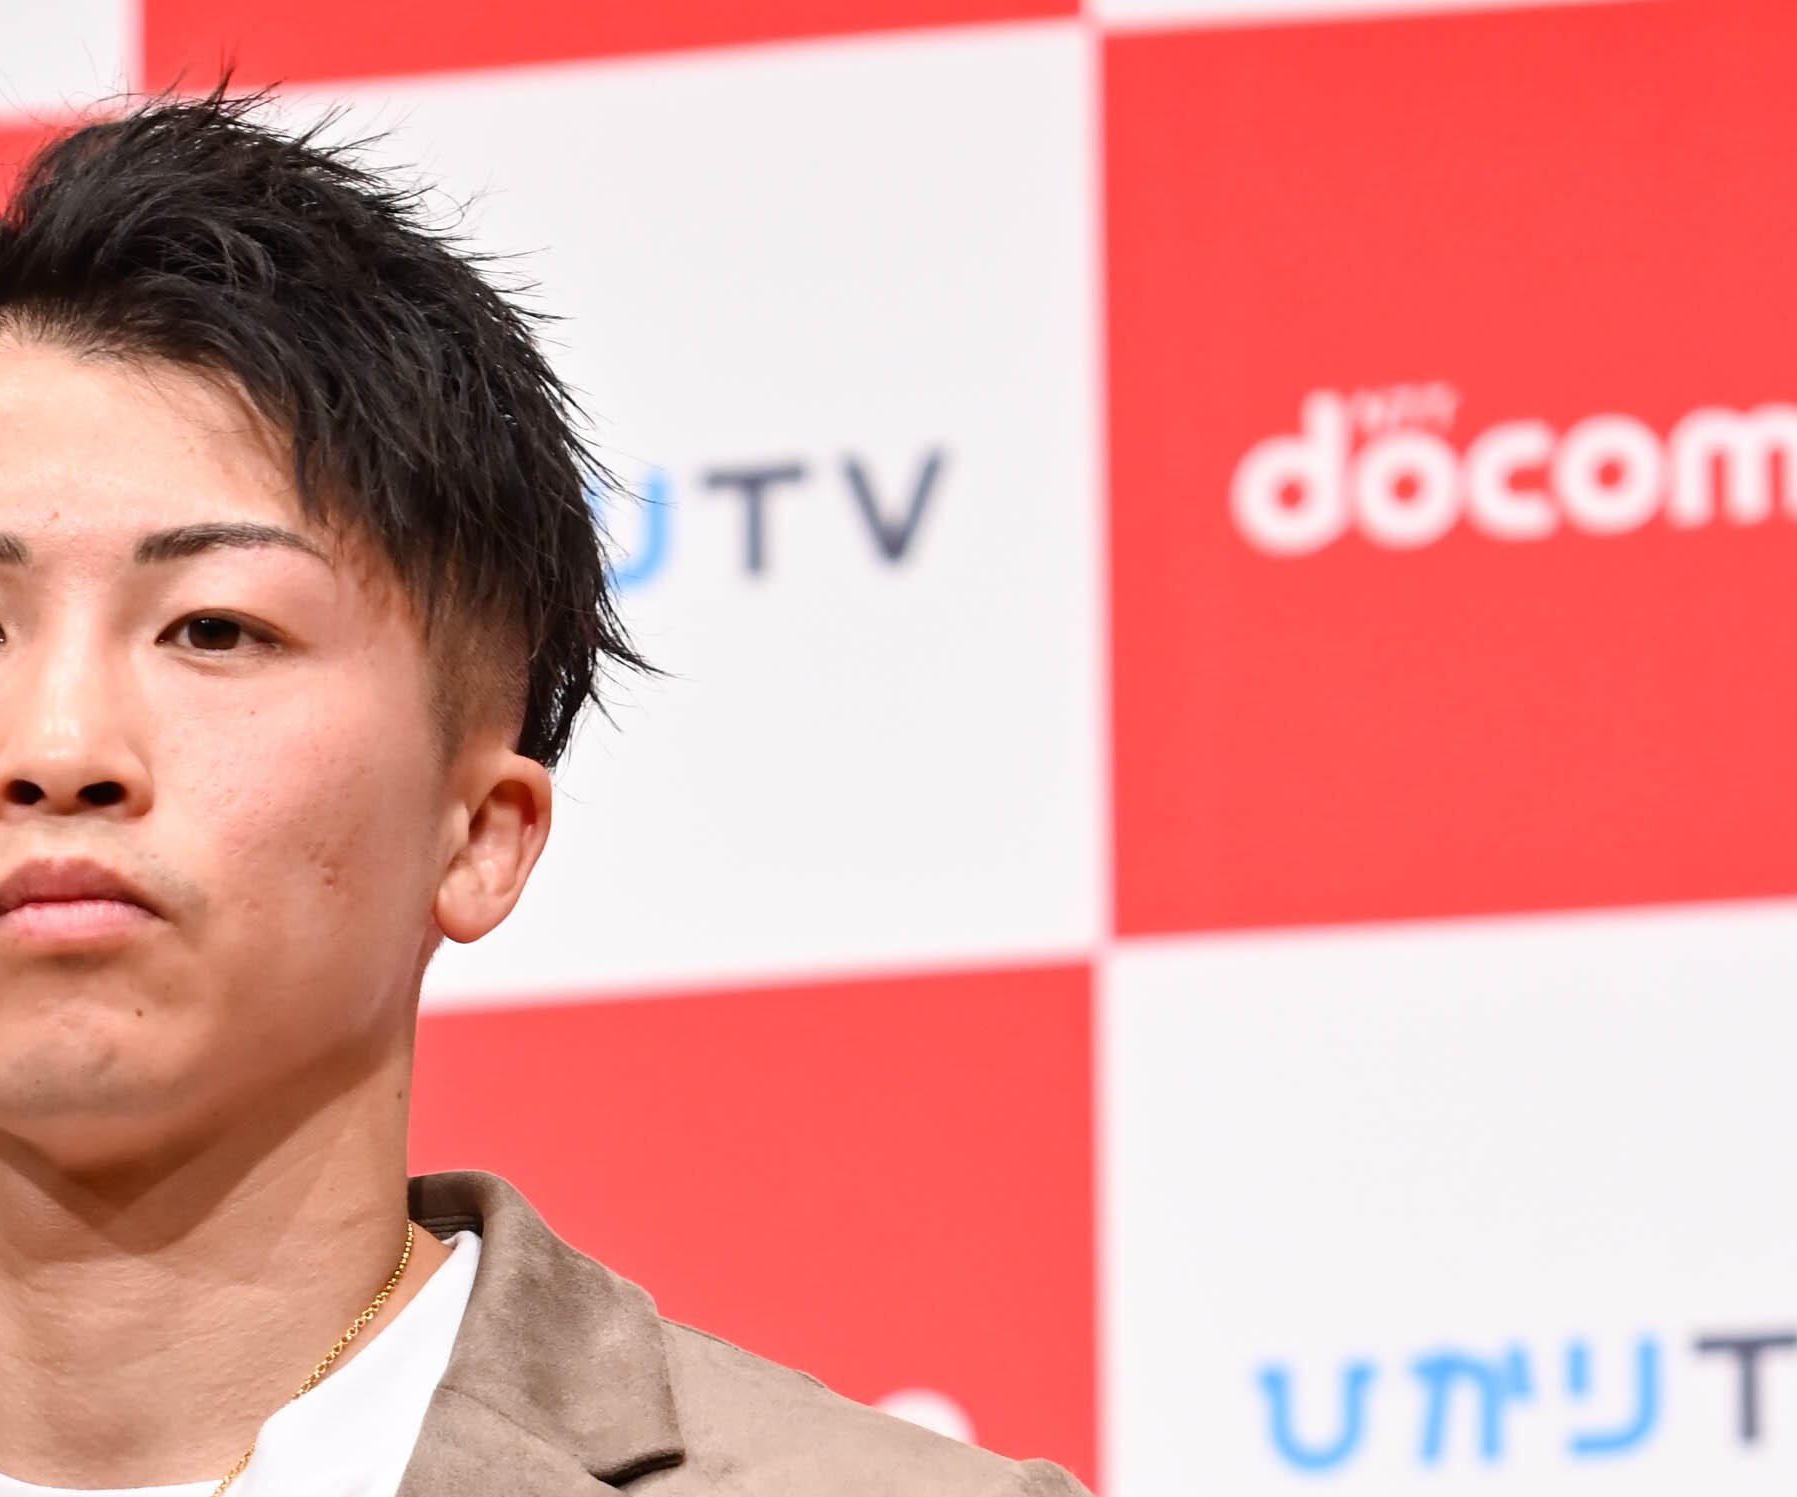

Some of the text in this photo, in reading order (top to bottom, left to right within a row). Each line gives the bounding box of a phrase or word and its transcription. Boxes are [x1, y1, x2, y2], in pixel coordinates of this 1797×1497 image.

[1228, 388, 1797, 557] docom
[1256, 1328, 1797, 1472] ひかりT
